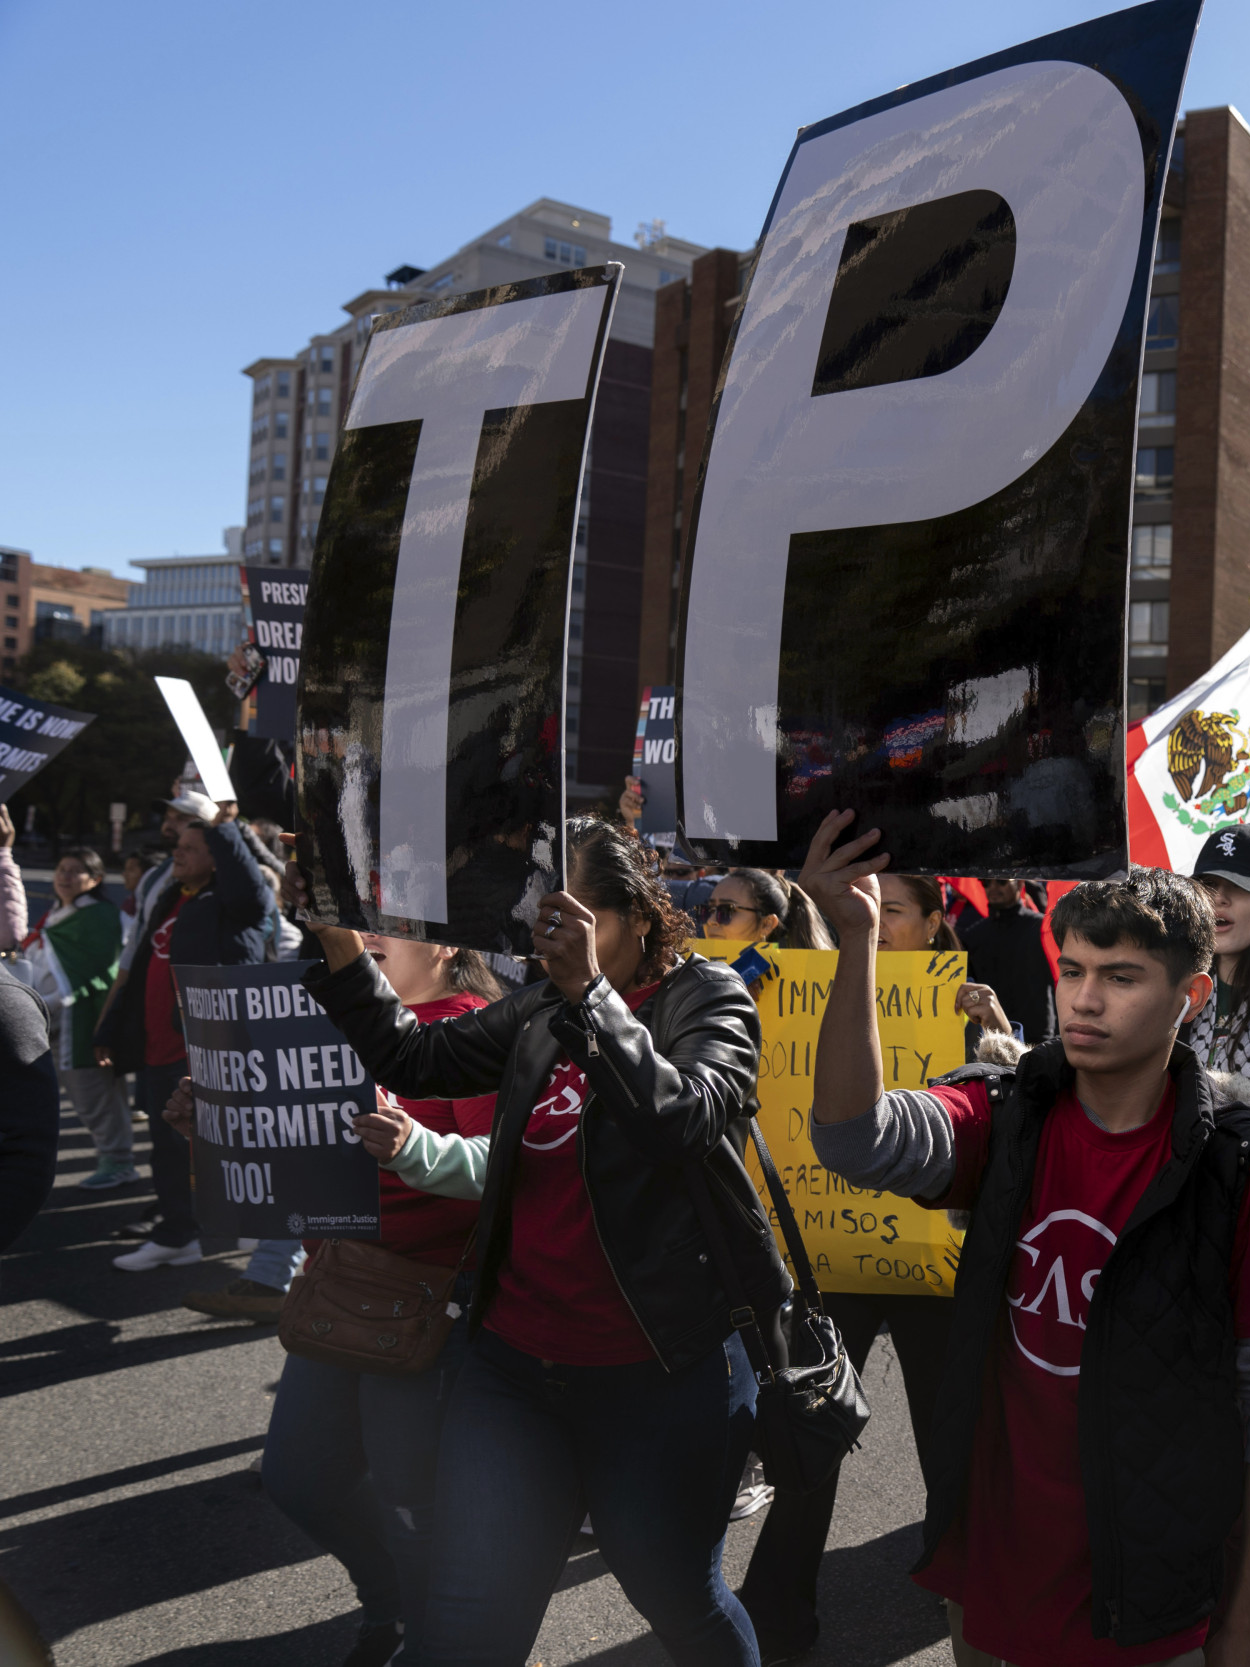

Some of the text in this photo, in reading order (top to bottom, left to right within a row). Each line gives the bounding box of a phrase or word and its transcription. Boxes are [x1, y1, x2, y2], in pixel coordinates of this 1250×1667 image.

[684, 60, 1145, 841] P
[261, 581, 308, 605] PRESI
[344, 284, 609, 925] T
[15, 708, 44, 730] IS
[186, 986, 239, 1021] PRESIDENT
[778, 978, 947, 1018] IMMRANT
[189, 1044, 366, 1092] DREAMERS NEED
[225, 1101, 363, 1148] PERMITS
[221, 1160, 275, 1204] TOO!
[307, 1214, 378, 1225] Immigrant Justice
[853, 1253, 943, 1286] TODOS
